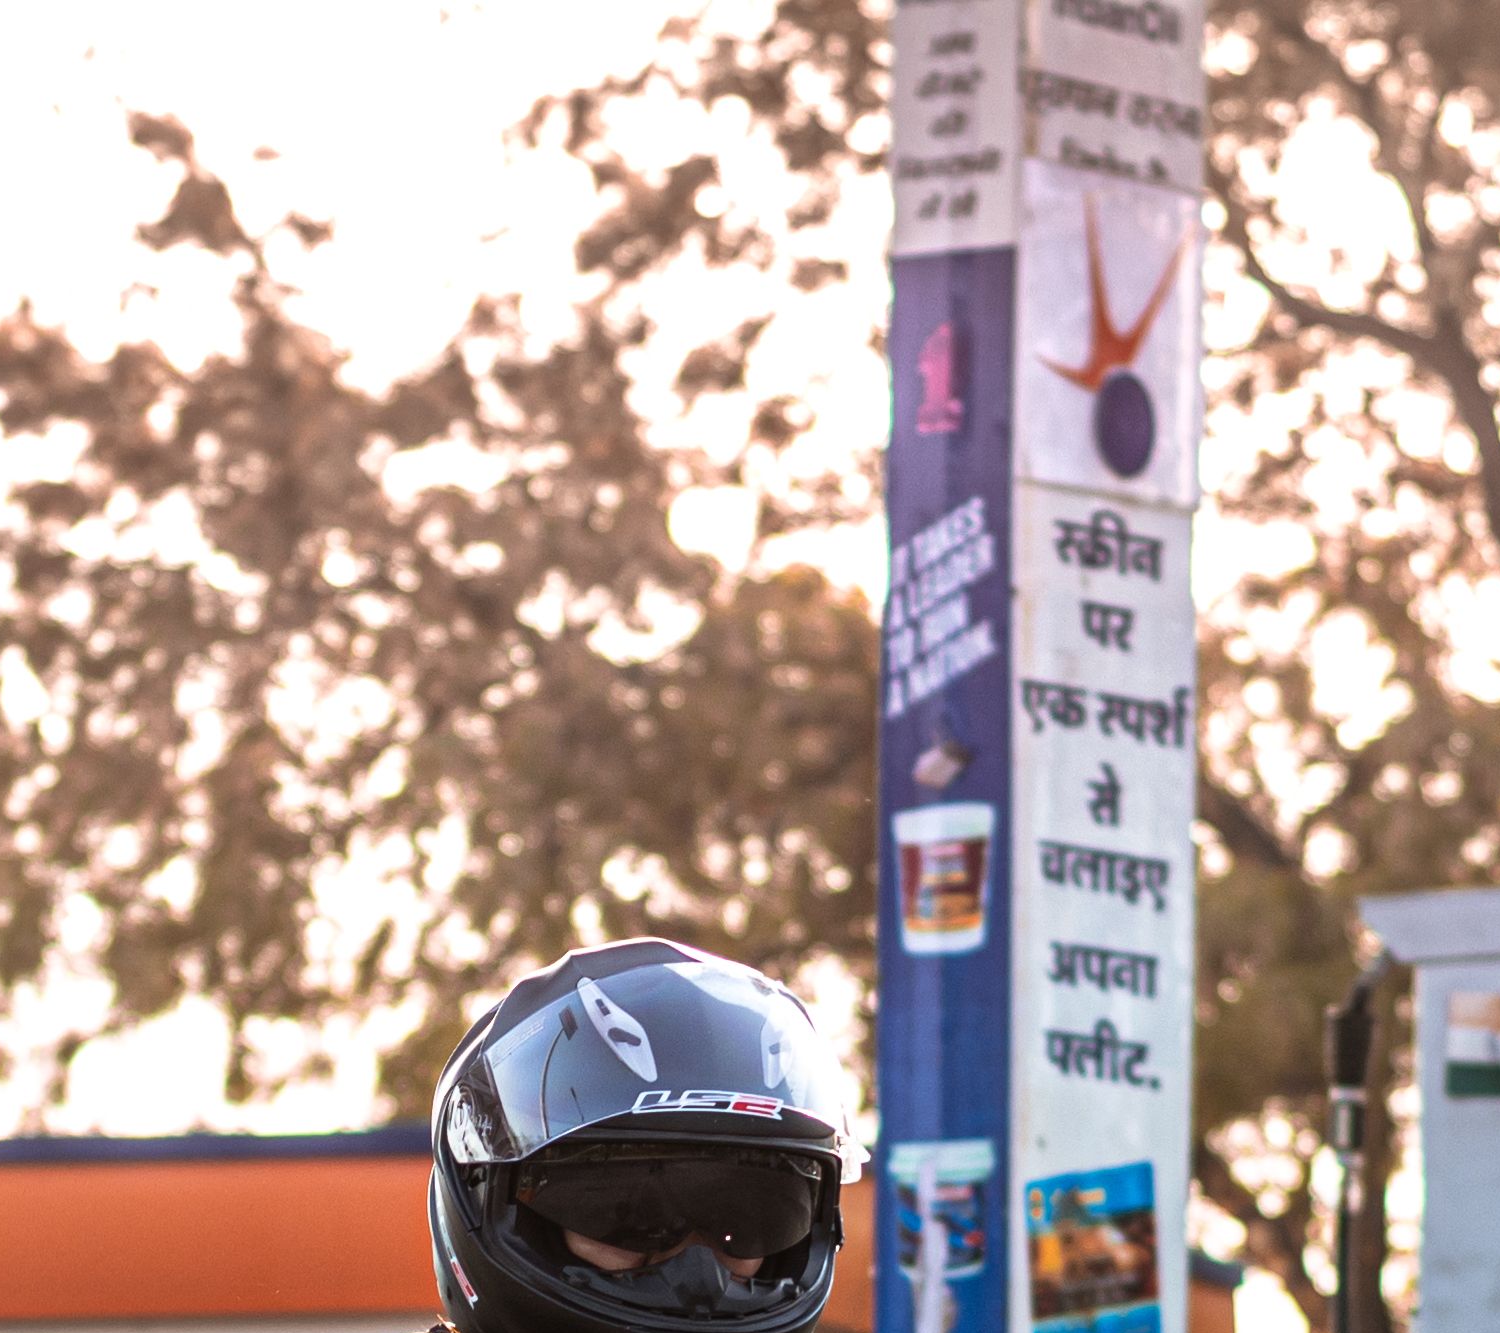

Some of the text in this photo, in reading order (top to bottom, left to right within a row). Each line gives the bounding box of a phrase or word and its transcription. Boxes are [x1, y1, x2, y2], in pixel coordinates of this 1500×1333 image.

[1082, 600, 1134, 652] पर
[1021, 679, 1087, 732] एक
[1087, 762, 1122, 827] से
[1039, 840, 1171, 912] चलाइए
[1048, 940, 1158, 999] अपना
[632, 1089, 783, 1120] LS2
